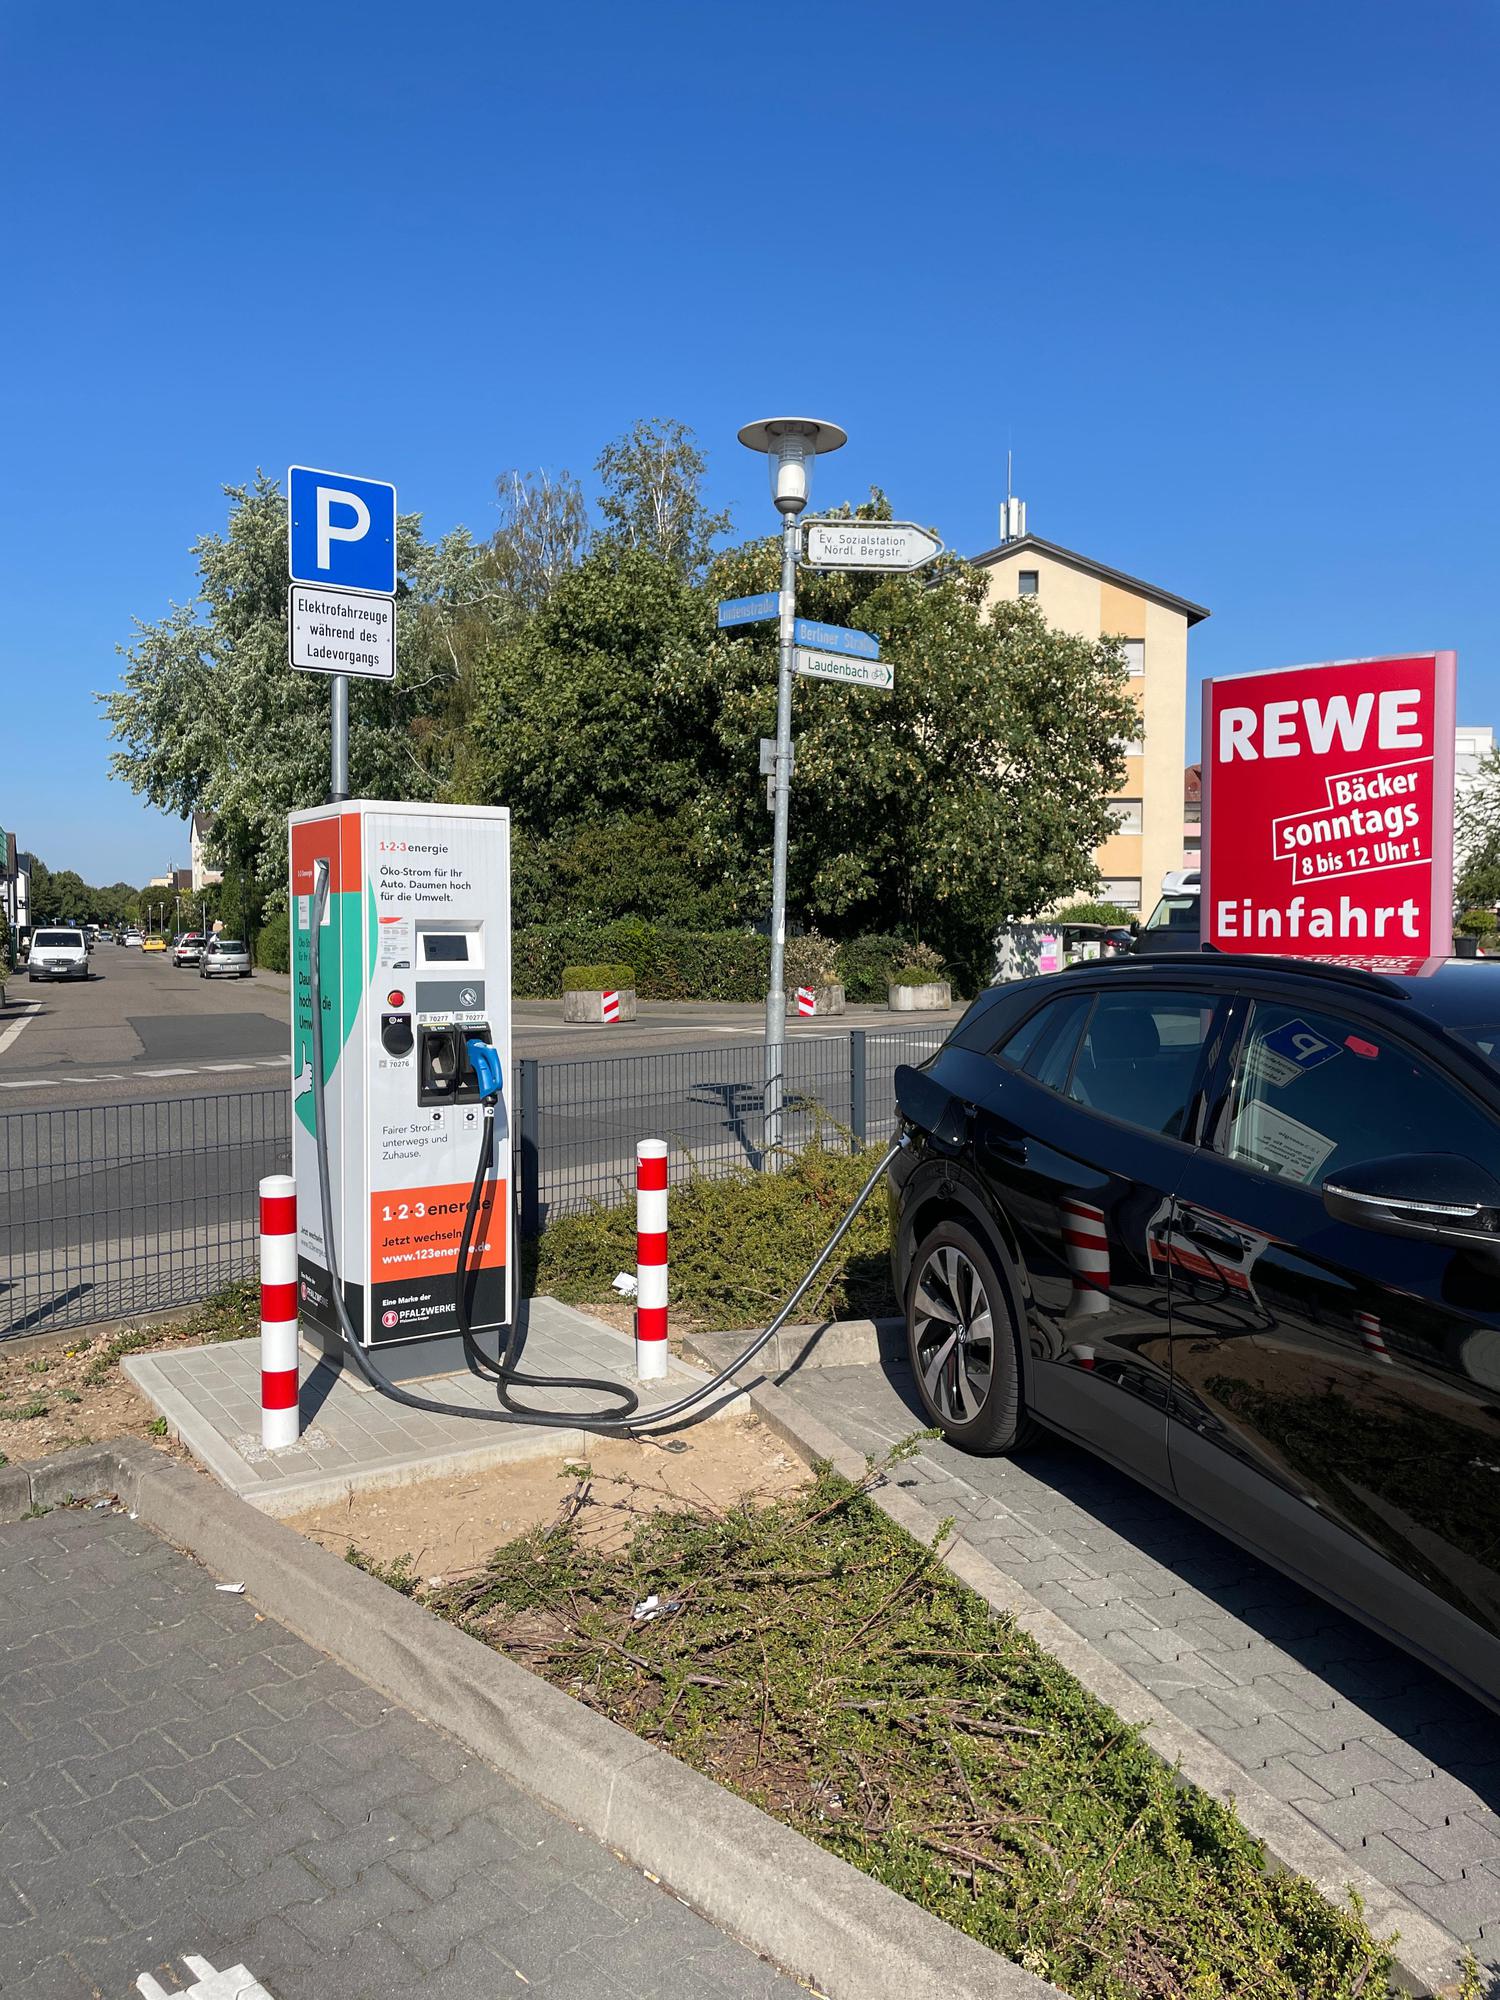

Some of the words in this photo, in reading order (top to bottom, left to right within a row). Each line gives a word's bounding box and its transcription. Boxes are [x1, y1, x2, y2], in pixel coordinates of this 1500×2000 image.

[316, 486, 371, 570] P
[839, 534, 906, 546] Sozialstation
[298, 598, 388, 625] Elektrofahrzeuge
[309, 623, 355, 640] während
[359, 629, 378, 643] des
[800, 624, 839, 645] Berliner
[307, 643, 380, 667] Ladevorgangs
[808, 656, 869, 679] Laudenbach
[1219, 689, 1423, 763] REWE
[1335, 772, 1418, 805] Bäcker
[1282, 803, 1420, 850] sonntags
[1301, 857, 1314, 876] 8
[1315, 852, 1343, 874] bis
[1346, 847, 1370, 868] 12
[1373, 841, 1409, 863] Uhr
[380, 865, 431, 877] Öko-Strom
[434, 867, 447, 877] für
[450, 868, 463, 877] Ihr
[380, 879, 406, 889] Auto.
[409, 880, 447, 890] Daumen
[450, 881, 471, 890] hoch
[380, 892, 394, 901] für
[397, 892, 412, 901] die
[415, 893, 454, 902] Umwelt.
[1217, 896, 1420, 938] Einfahrt
[390, 1060, 410, 1068] 70276
[382, 1125, 408, 1135] Fairer
[382, 1137, 429, 1148] unterwegs
[431, 1134, 448, 1144] und
[382, 1150, 421, 1161] Zuhause.
[382, 1235, 410, 1248] Jetzt
[382, 1241, 491, 1264] www.123enere.de
[398, 1296, 419, 1304] Marke
[399, 1303, 456, 1319] PFALZWERKE
